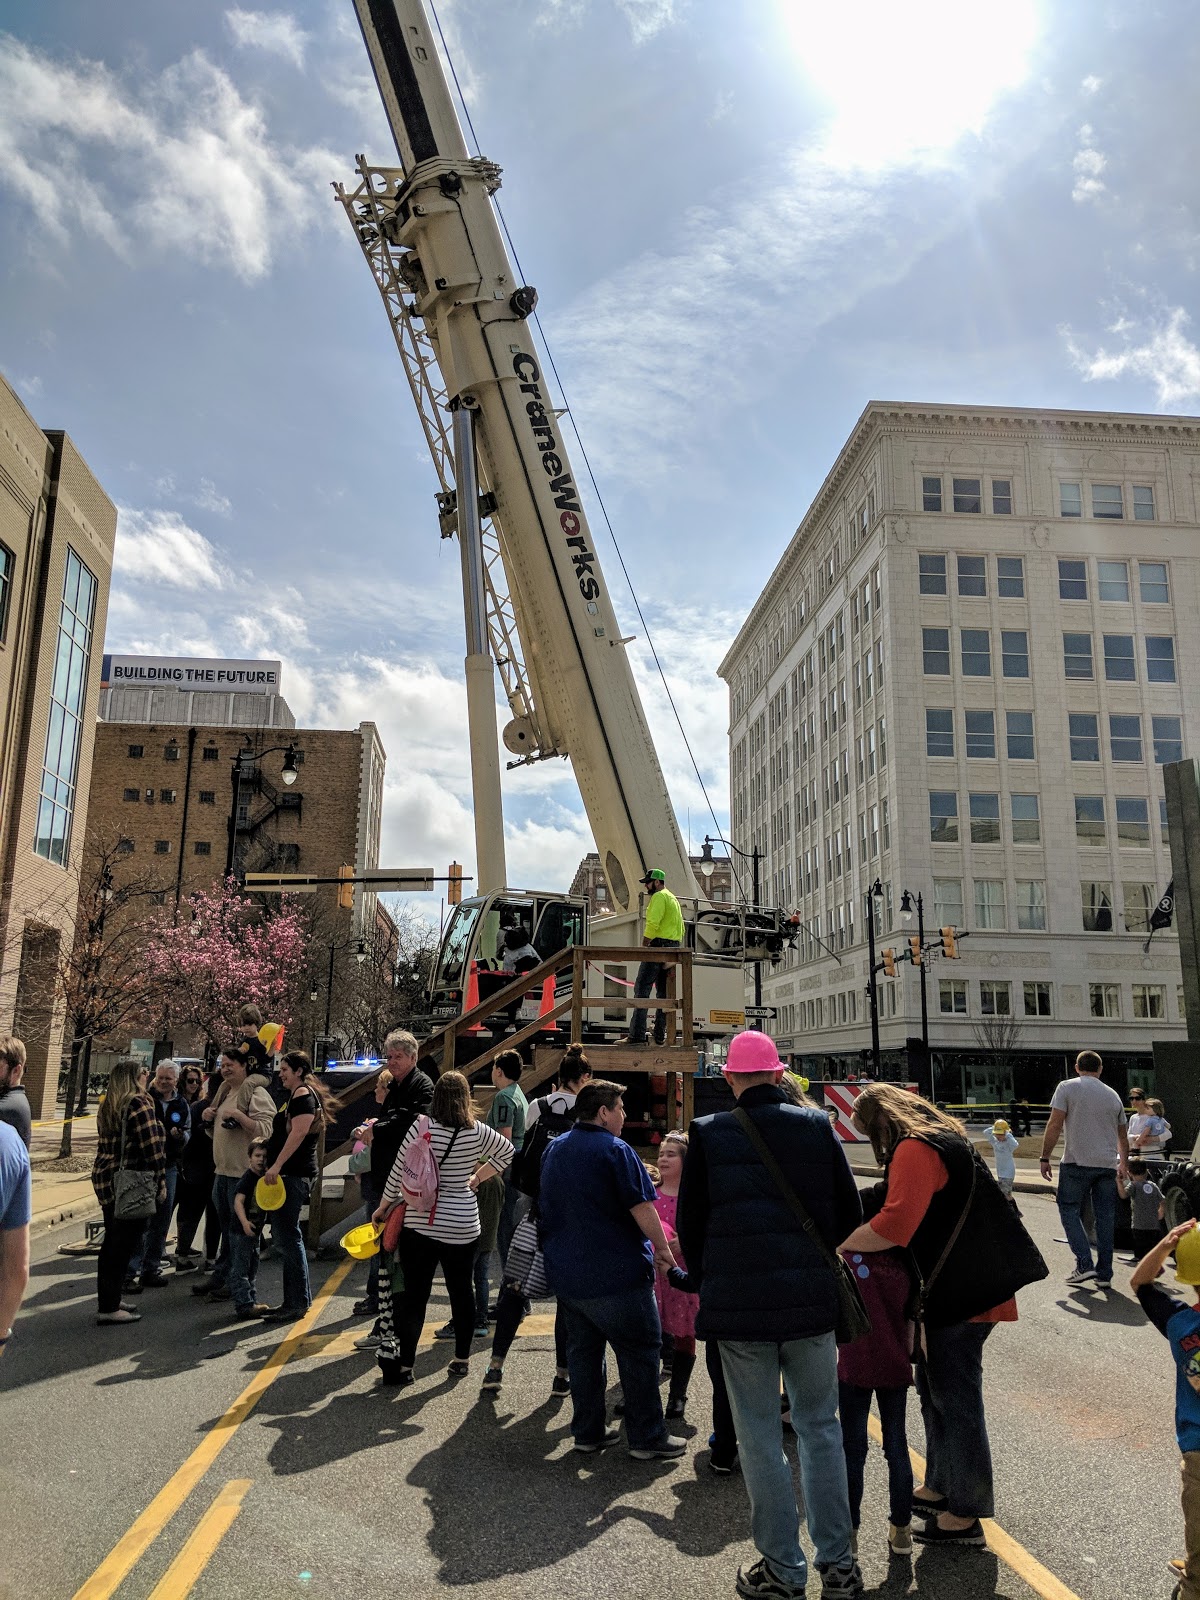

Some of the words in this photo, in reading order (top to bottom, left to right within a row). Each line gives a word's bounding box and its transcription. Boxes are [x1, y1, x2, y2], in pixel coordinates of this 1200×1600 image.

[512, 352, 600, 601] CraneWorks
[114, 666, 183, 681] BUILDING
[185, 668, 215, 683] THE
[217, 670, 276, 685] FUTURE
[438, 1006, 458, 1015] TEREX
